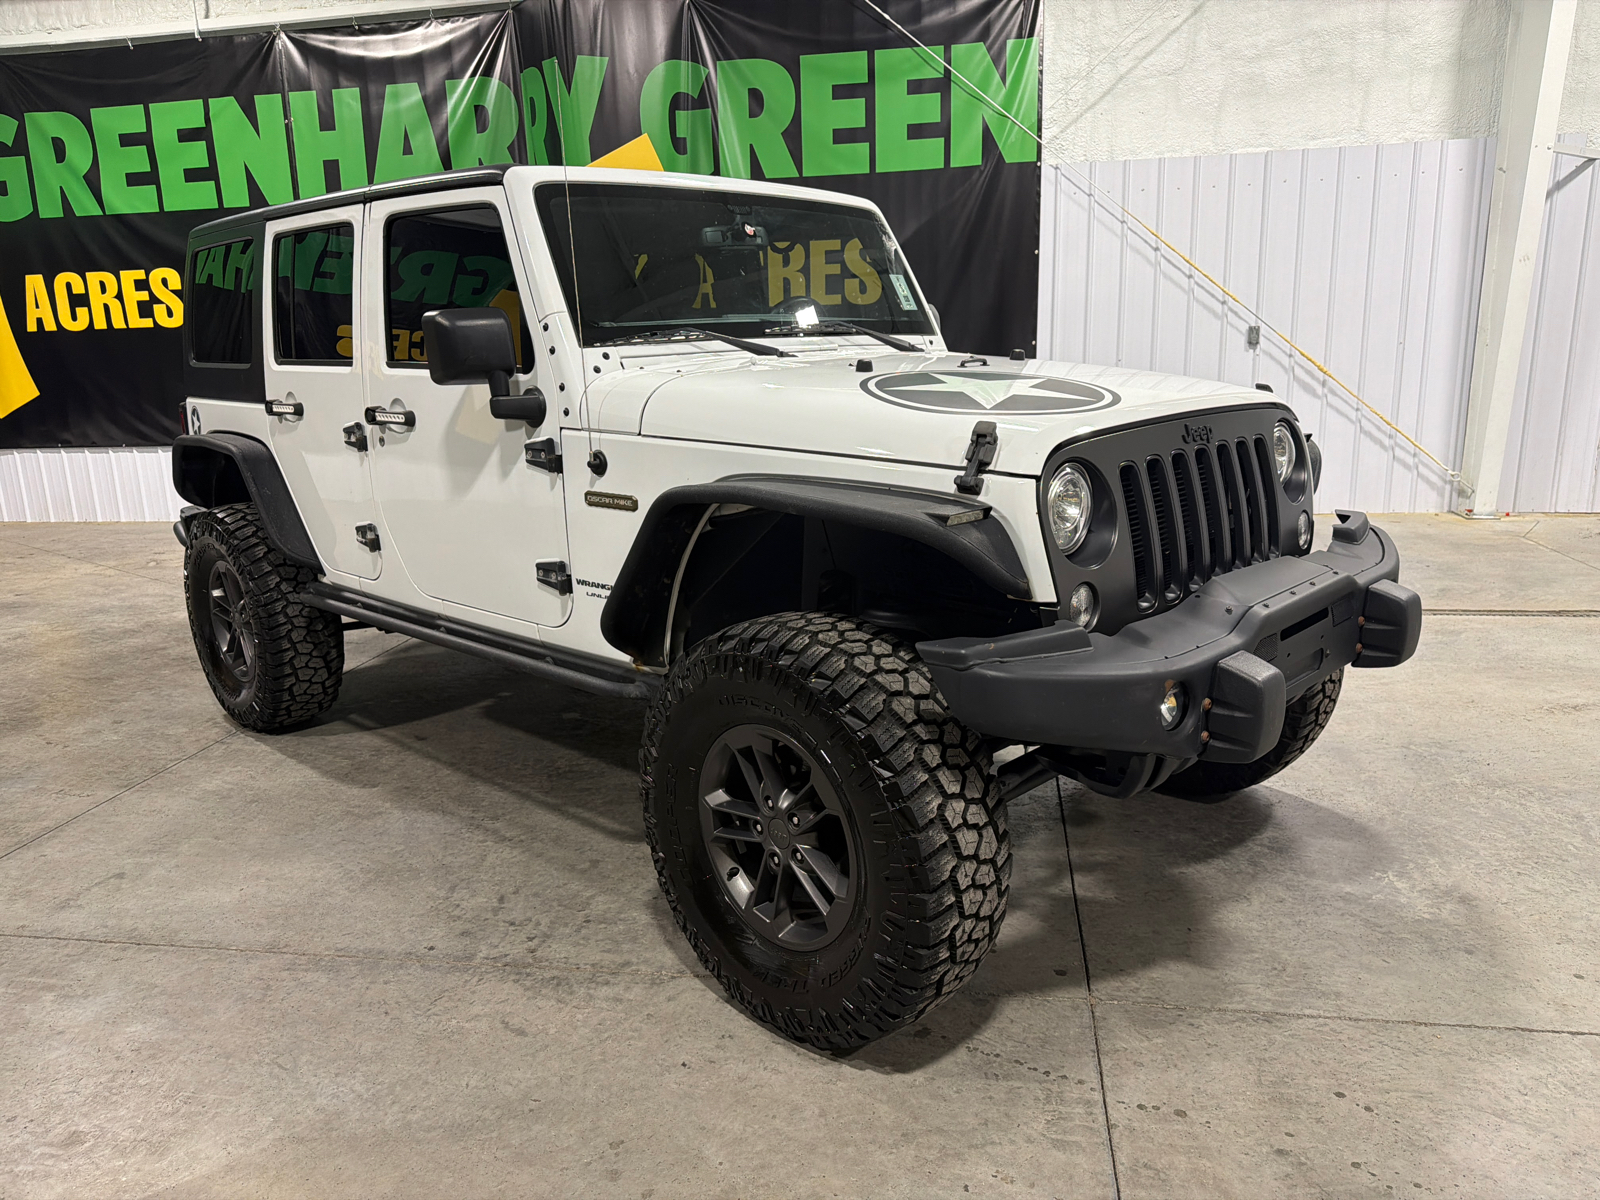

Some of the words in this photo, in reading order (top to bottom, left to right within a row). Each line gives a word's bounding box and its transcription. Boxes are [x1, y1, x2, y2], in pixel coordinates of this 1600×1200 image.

[639, 37, 1039, 179] GREEN
[0, 93, 294, 222] GREEN
[25, 267, 184, 332] ACRES
[1181, 422, 1213, 444] Jeep
[587, 495, 614, 504] OSCAR
[614, 498, 633, 506] MIKE
